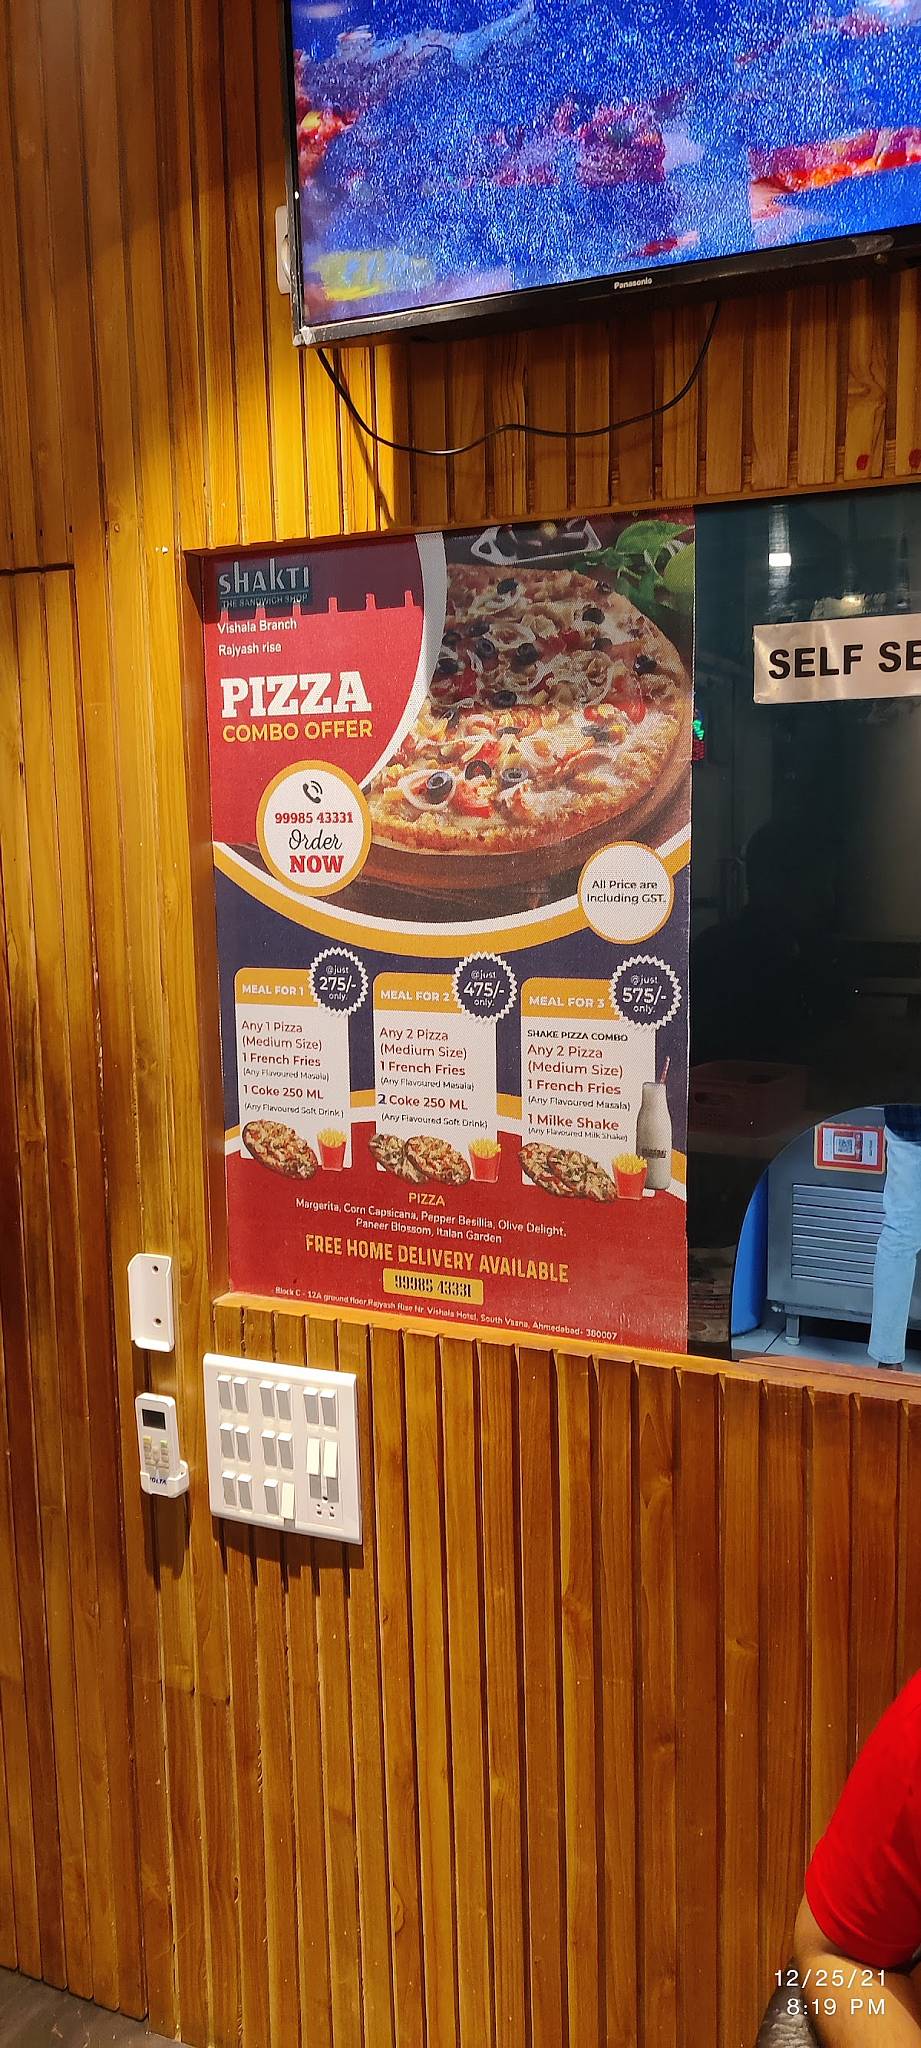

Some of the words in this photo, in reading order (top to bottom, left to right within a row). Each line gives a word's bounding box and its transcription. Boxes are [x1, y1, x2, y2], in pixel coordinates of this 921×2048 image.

[614, 276, 652, 290] Panasonic
[218, 558, 310, 595] SHAKTI
[217, 620, 256, 634] Vishala
[260, 618, 297, 632] Branch
[218, 642, 259, 657] Rajyash
[262, 641, 282, 654] rise
[768, 644, 864, 680] SELF
[220, 671, 372, 718] PIZZA
[222, 722, 299, 742] COMBO
[304, 719, 373, 740] OFFER
[275, 812, 313, 824] 99985
[316, 812, 353, 824] 43331
[288, 828, 342, 850] Order
[289, 855, 344, 873] NOW
[591, 880, 606, 889] All
[609, 879, 637, 889] Price
[639, 881, 657, 889] are
[642, 894, 666, 903] GST.
[325, 965, 349, 975] @just
[470, 970, 496, 980] @just
[319, 975, 356, 993] 275/-
[630, 975, 658, 985] @just
[242, 984, 272, 994] MEAL
[275, 985, 297, 995] FOR
[299, 987, 304, 996] 1
[328, 993, 348, 1001] only.
[381, 989, 412, 1000] MEAL
[416, 990, 439, 1001] FOR
[443, 992, 450, 1002] 2
[463, 981, 504, 999] 475/-
[622, 985, 667, 1005] 575/-
[474, 999, 495, 1008] only.
[529, 996, 564, 1007] MEAL
[567, 997, 593, 1008] FOR
[597, 998, 605, 1009] 3
[633, 1005, 655, 1015] only.
[241, 1020, 263, 1034] Any
[266, 1021, 270, 1031] 1
[274, 1021, 303, 1033] Pizza
[380, 1027, 403, 1041] Any
[407, 1029, 414, 1039] 2
[417, 1028, 449, 1041] Pizza
[242, 1035, 292, 1049] (Medium
[295, 1038, 322, 1050] Size)
[527, 1029, 558, 1039] SHAKE
[561, 1032, 589, 1040] PIZZA
[591, 1033, 628, 1042] COMBO
[380, 1043, 435, 1057] (Medium
[438, 1046, 467, 1061] Size)
[527, 1044, 553, 1058] Any
[556, 1046, 564, 1056] 2
[568, 1046, 603, 1059] Pizza
[250, 1053, 290, 1065] French
[293, 1055, 321, 1067] Fries
[243, 1067, 259, 1077] (Any
[380, 1061, 385, 1071] 1
[389, 1061, 431, 1074] French
[435, 1064, 466, 1076] Fries
[528, 1061, 587, 1075] (Medium
[591, 1063, 623, 1078] Size)
[380, 1077, 399, 1087] (Any
[401, 1078, 441, 1088] Flavoured
[527, 1079, 532, 1089] 1
[537, 1080, 583, 1092] French
[588, 1082, 621, 1095] Fries
[243, 1084, 248, 1094] 1
[251, 1085, 280, 1096] Coke
[283, 1087, 303, 1098] 250
[306, 1089, 323, 1100] ML
[244, 1102, 261, 1113] (Any
[262, 1103, 299, 1114] Flavoured
[301, 1106, 316, 1116] Soft
[377, 1093, 387, 1105] 2
[389, 1095, 420, 1107] Coke
[423, 1097, 446, 1109] 250
[449, 1098, 468, 1110] ML
[528, 1096, 547, 1105] (Any
[550, 1097, 594, 1108] Flavoured
[596, 1101, 631, 1111] Masala)
[381, 1113, 400, 1123] (Any
[401, 1114, 442, 1125] Flavoured
[443, 1117, 460, 1126] Soft
[462, 1119, 488, 1129] Drink)
[528, 1113, 533, 1123] 1
[537, 1114, 573, 1127] Milke
[576, 1117, 619, 1130] Shake
[408, 1192, 446, 1207] PIZZA
[295, 1198, 341, 1213] Margerita,
[343, 1203, 366, 1215] Corn
[368, 1205, 419, 1220] Capsicana,
[421, 1211, 455, 1226] Pepper
[498, 1219, 523, 1231] Olive
[526, 1223, 567, 1237] Delight,
[356, 1218, 388, 1231] Paneer
[391, 1222, 434, 1237] Blossom,
[466, 1230, 502, 1243] Garden
[305, 1234, 343, 1255] FREE
[347, 1238, 393, 1261] HOME
[398, 1244, 474, 1272] DELIVERY
[479, 1254, 569, 1283] AVAILABLE
[394, 1274, 433, 1292] 99985
[437, 1280, 472, 1298] 43331
[275, 1286, 294, 1297] Block
[296, 1289, 301, 1297] C
[307, 1291, 322, 1299] 12A
[480, 1314, 503, 1324] South
[585, 1328, 617, 1340] 380007
